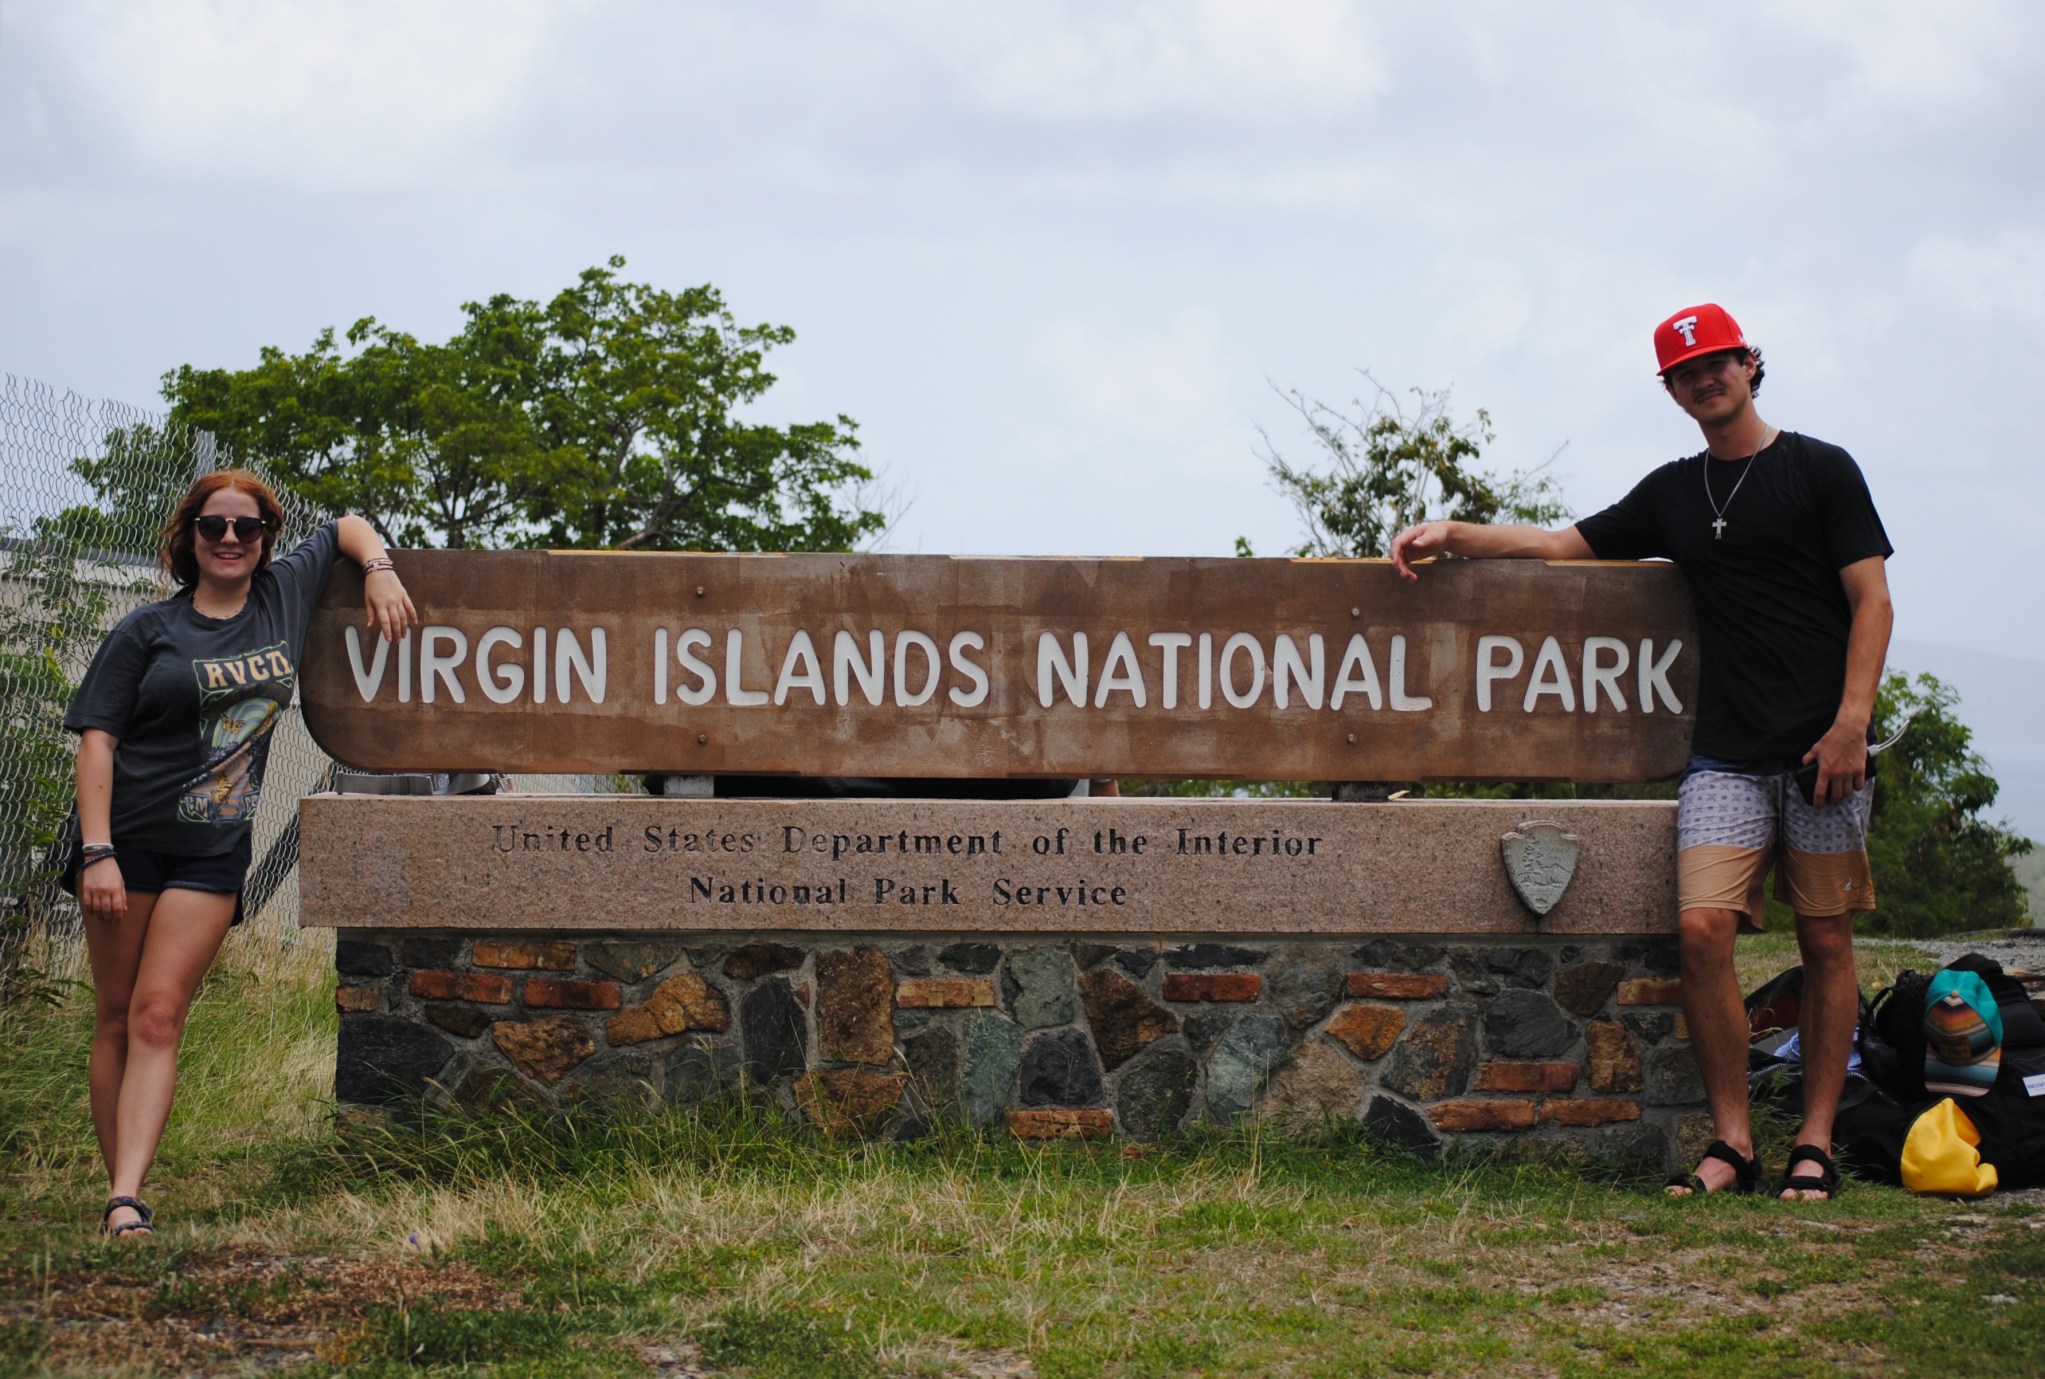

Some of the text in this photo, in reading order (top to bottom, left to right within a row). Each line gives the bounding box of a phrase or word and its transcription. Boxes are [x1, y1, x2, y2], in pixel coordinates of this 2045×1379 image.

[345, 625, 1683, 715] VIRGIN ISLANDS NATIONAL PARK
[491, 825, 1323, 862] United States Department of the Interior
[689, 876, 1127, 906] National Park Service
